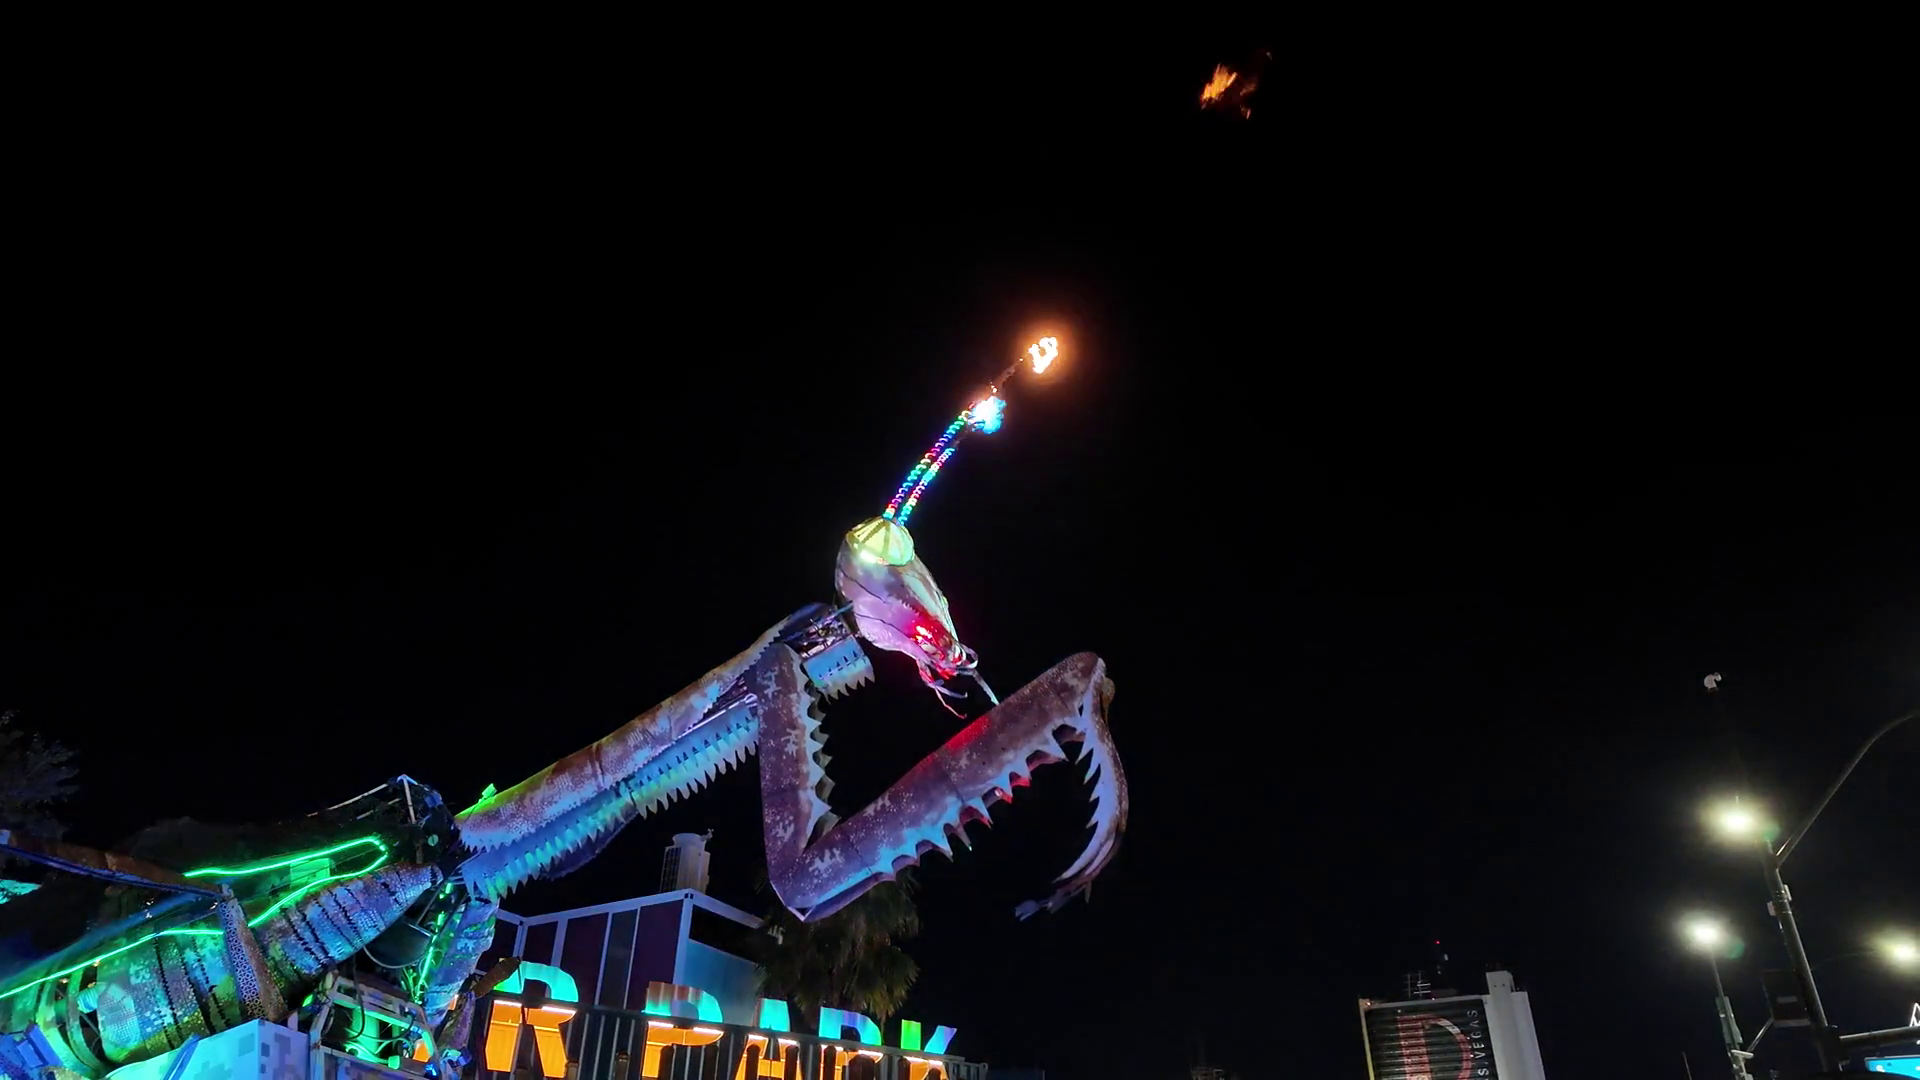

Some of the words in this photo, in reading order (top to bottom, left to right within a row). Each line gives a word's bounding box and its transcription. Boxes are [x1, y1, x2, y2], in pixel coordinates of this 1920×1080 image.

[485, 960, 579, 1079] R
[640, 981, 958, 1080] PARK
[1467, 1010, 1486, 1059] VEGAS
